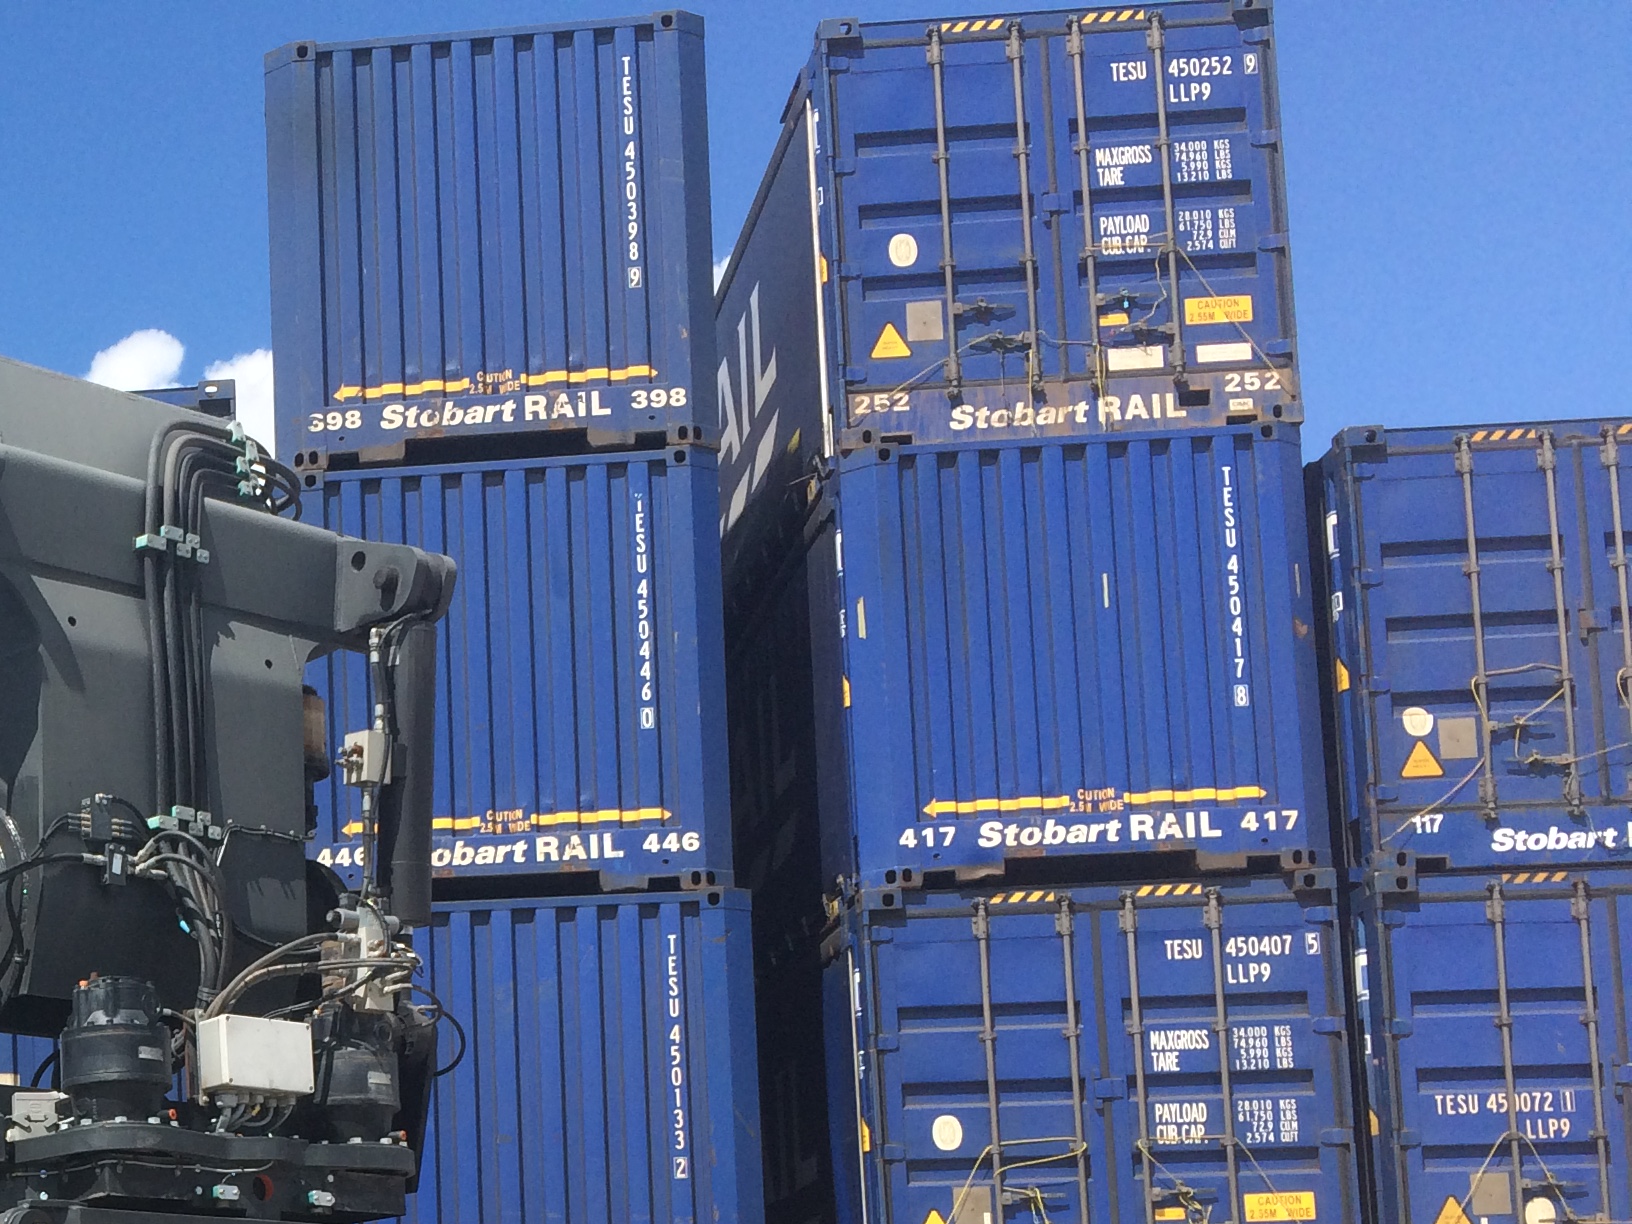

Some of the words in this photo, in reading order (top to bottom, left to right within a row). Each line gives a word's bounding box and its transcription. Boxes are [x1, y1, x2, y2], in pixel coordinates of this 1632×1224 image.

[1110, 61, 1147, 82] TESU
[1168, 56, 1233, 77] 450252
[1244, 54, 1258, 74] 9
[621, 56, 634, 135] TESU
[1169, 82, 1211, 103] LLP9
[1174, 140, 1207, 152] 34.000
[1213, 139, 1230, 150] KGS
[1175, 151, 1208, 162] 74.960
[1214, 149, 1231, 160] LBS
[1095, 145, 1152, 167] MAXGROSS
[1181, 161, 1208, 171] 5.990
[1215, 159, 1232, 170] KGS
[1097, 167, 1125, 187] TARE
[1177, 171, 1209, 182] 13.210
[1216, 169, 1233, 180] LBS
[624, 141, 639, 261] 450398
[1218, 208, 1235, 219] KGS
[1099, 214, 1150, 236] PAYLOAD
[1178, 220, 1212, 231] 61.750
[1219, 218, 1236, 229] LBS
[1192, 230, 1213, 240] 72.9
[1186, 240, 1214, 251] 2.574
[629, 267, 641, 287] 9
[1197, 299, 1240, 310] CAUTION
[1223, 309, 1249, 320] WIDE
[718, 280, 777, 465] AIL
[308, 411, 362, 432] 398
[380, 399, 516, 430] Stobart
[524, 391, 612, 421] RAIL
[630, 388, 687, 410] 398
[854, 393, 911, 415] 252
[949, 399, 1090, 431] Stobart
[1097, 393, 1188, 423] RAIL
[1224, 372, 1282, 393] 252
[1221, 466, 1236, 548] TESU
[635, 493, 647, 574] TESU
[1227, 554, 1244, 679] 450417
[637, 579, 652, 701] 450446
[1234, 685, 1249, 706] 8
[641, 708, 654, 728] 0
[899, 827, 956, 848] 417
[977, 819, 1122, 848] Stobart
[1130, 811, 1222, 840] RAIL
[1241, 810, 1299, 832] 417
[1412, 813, 1444, 834] 117
[1491, 826, 1618, 853] Stobart
[432, 839, 527, 868] obart
[536, 836, 624, 863] RAIL
[642, 832, 701, 854] 446
[1164, 939, 1203, 960] TESU
[1225, 935, 1293, 957] 450407
[1305, 933, 1320, 954] 5
[667, 934, 680, 1018] TESU
[1227, 962, 1271, 984] LLP9
[1150, 1029, 1210, 1051] MAXGROSS
[1232, 1026, 1267, 1038] 34.000
[1274, 1025, 1292, 1036] KGS
[1233, 1037, 1268, 1048] 74.960
[1275, 1036, 1292, 1047] LBS
[1151, 1052, 1180, 1072] TARE
[1240, 1048, 1269, 1059] 5.990
[1276, 1047, 1294, 1058] KGS
[1235, 1059, 1270, 1070] 13.210
[1277, 1058, 1294, 1069] LBS
[670, 1024, 685, 1150] 450133
[1155, 1102, 1207, 1123] PAYLOAD
[1279, 1099, 1297, 1109] KGS
[1434, 1094, 1479, 1115] TESU
[1238, 1111, 1273, 1122] 61.750
[1280, 1110, 1298, 1121] LBS
[1252, 1121, 1273, 1132] 72.9
[1526, 1118, 1571, 1140] LLP9
[1246, 1132, 1275, 1143] 2.574
[674, 1158, 688, 1178] 2
[1257, 1195, 1302, 1206] CAUTION
[1285, 1207, 1312, 1218] WIDE
